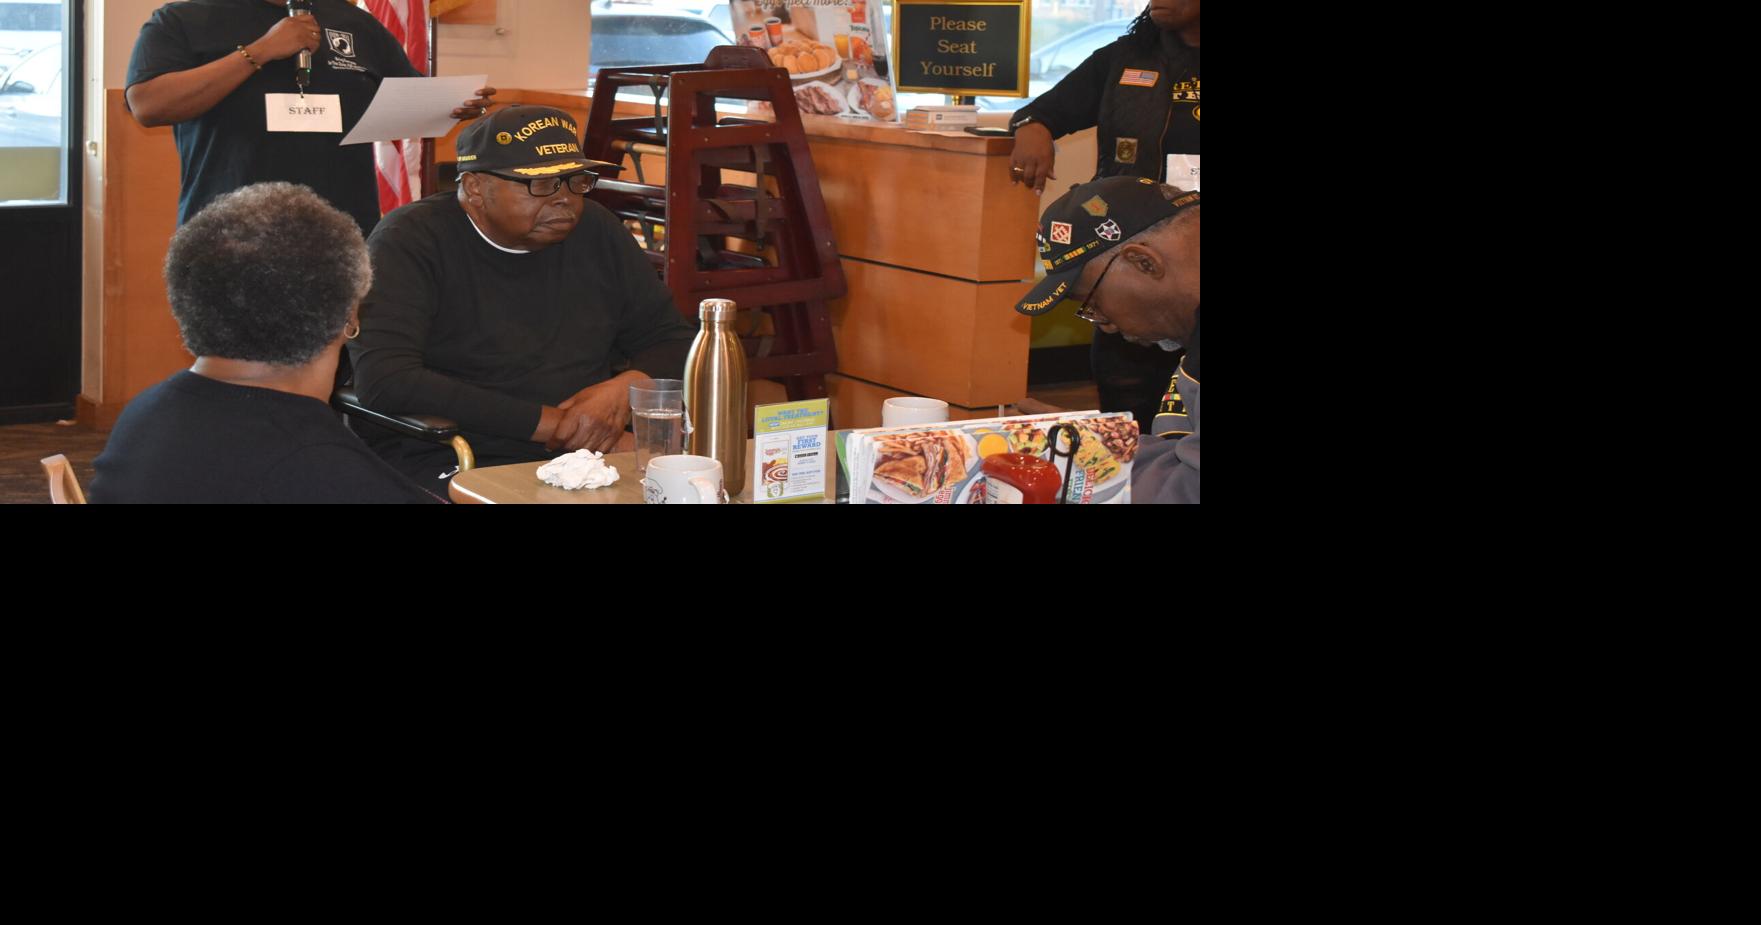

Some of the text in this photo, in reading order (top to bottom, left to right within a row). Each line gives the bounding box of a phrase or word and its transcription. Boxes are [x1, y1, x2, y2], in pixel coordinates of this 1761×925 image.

[930, 16, 987, 31] Please
[937, 39, 977, 54] Seat
[920, 61, 997, 77] Yourself
[288, 106, 326, 115] STAFF
[514, 117, 559, 142] KOREAN
[535, 143, 579, 156] VETERAN
[1022, 281, 1067, 311] VIETNAM VET
